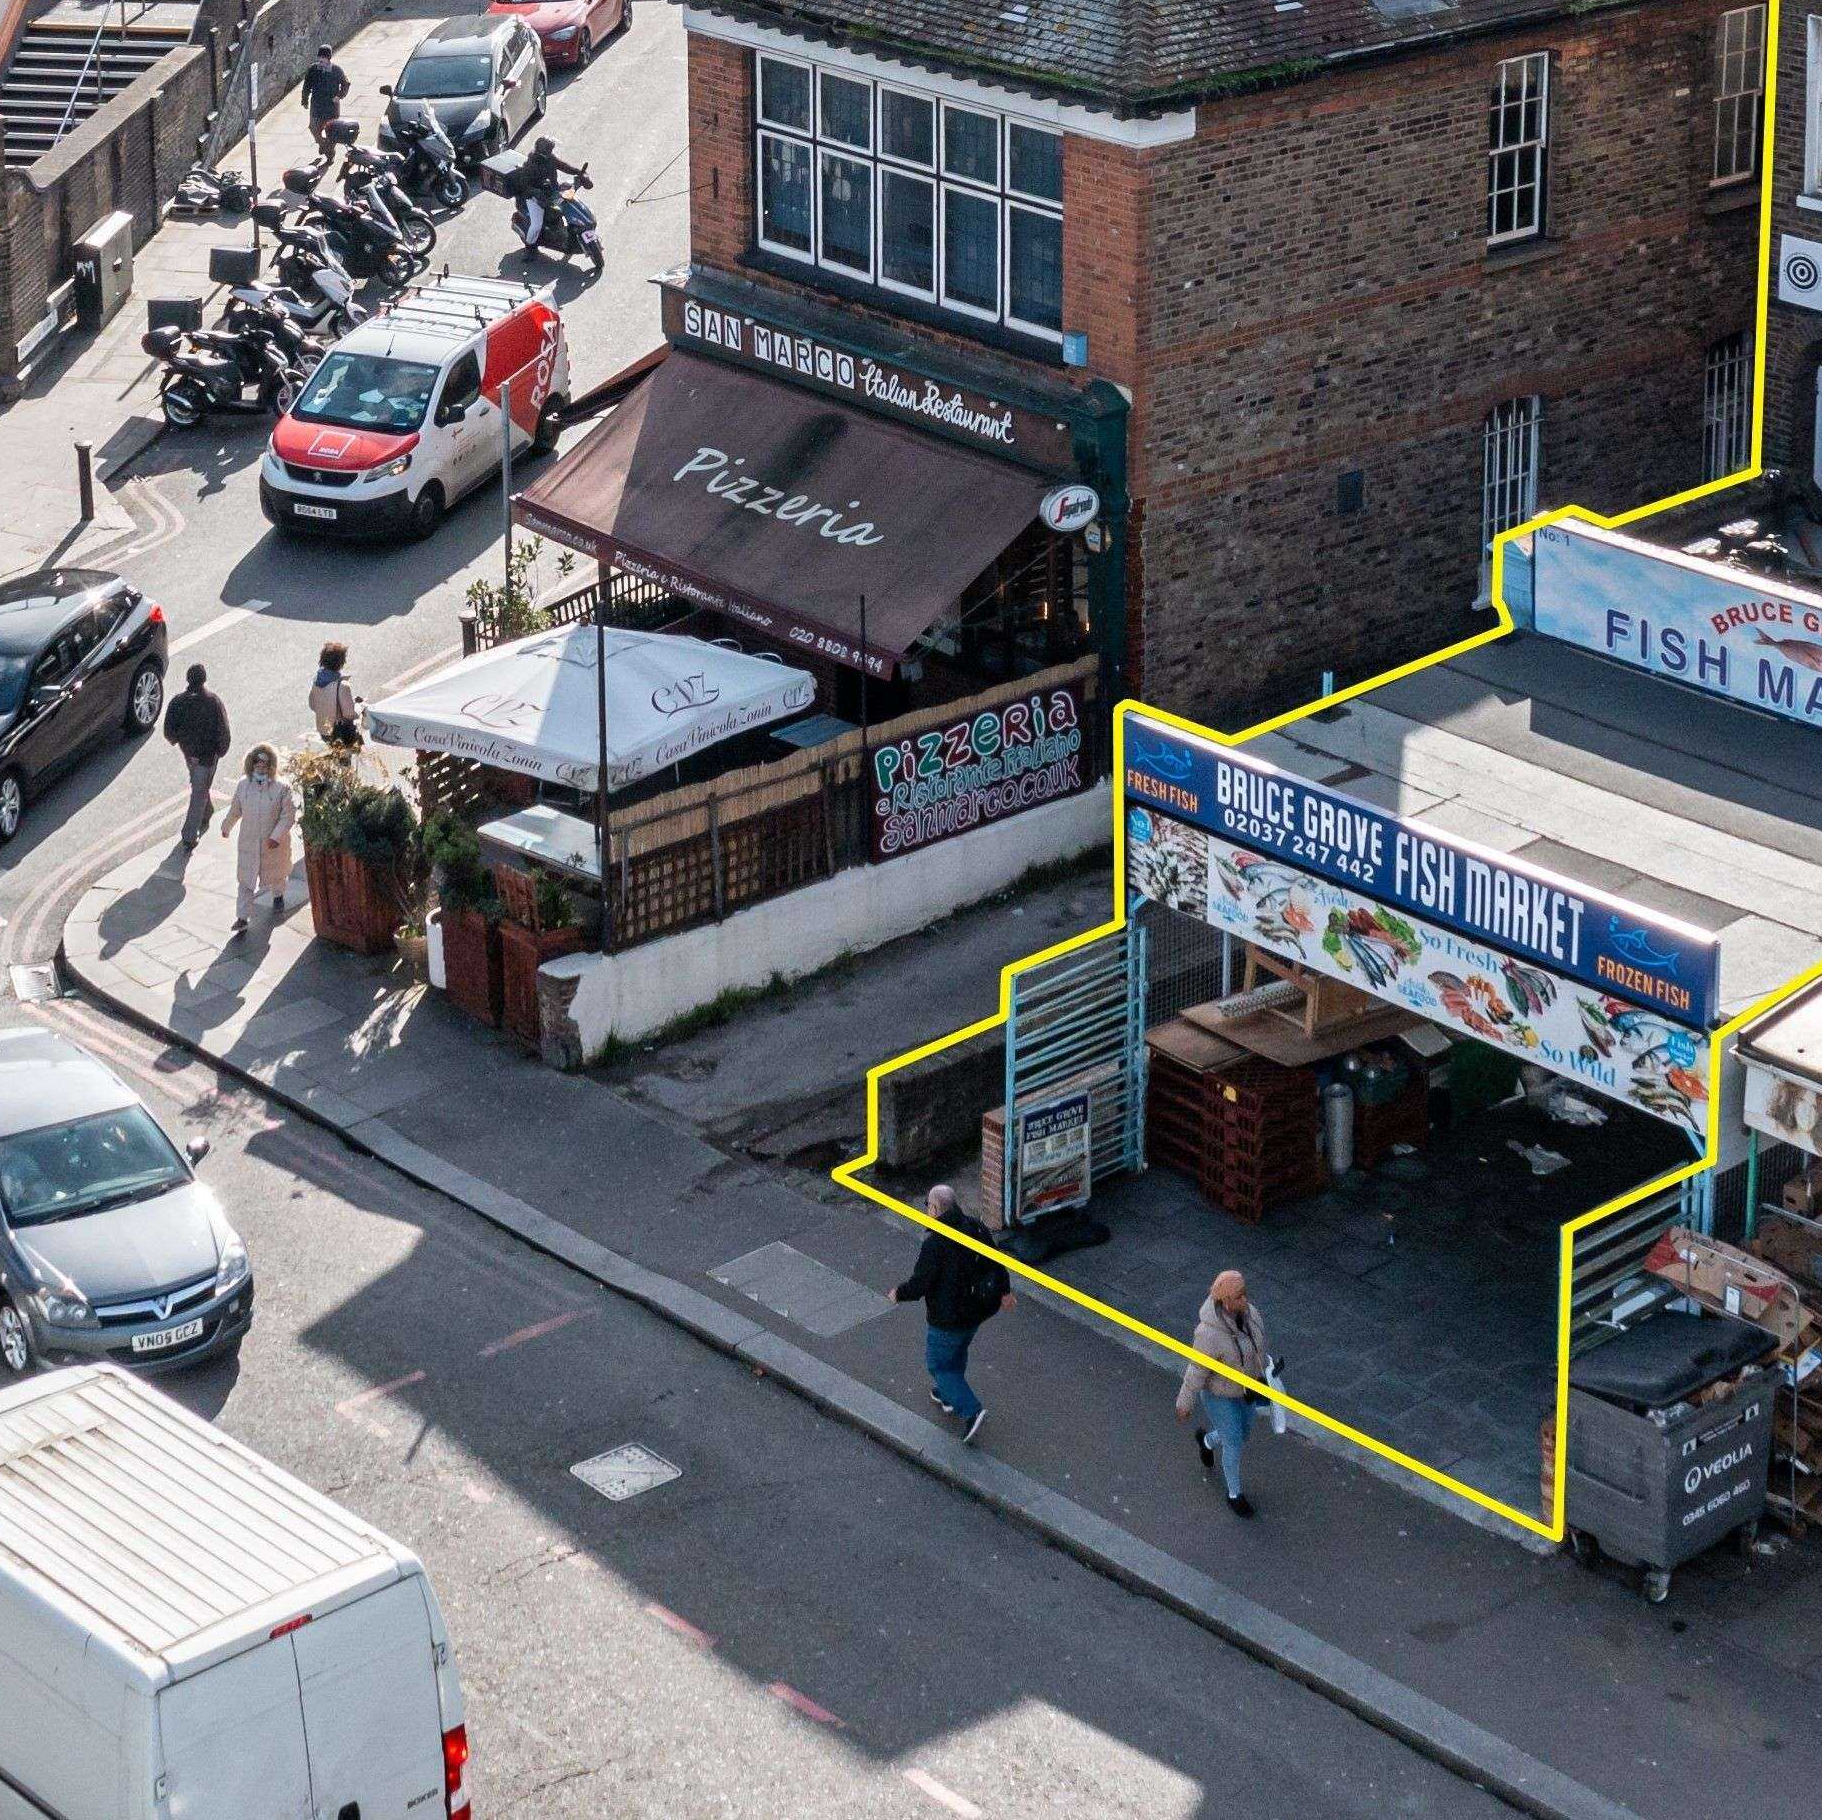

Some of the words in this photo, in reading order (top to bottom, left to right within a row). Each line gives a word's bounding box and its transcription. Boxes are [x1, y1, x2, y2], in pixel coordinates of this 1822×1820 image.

[686, 304, 741, 349] SAN
[755, 326, 854, 388] MARCO
[860, 362, 919, 410] Italian
[917, 381, 1014, 444] Restaurant
[673, 446, 883, 548] Pizzeria
[614, 550, 659, 580] Pizzeria
[1605, 607, 1729, 688] FISH
[1710, 601, 1793, 636] BRUCE
[892, 754, 1004, 815] Ristorante
[1126, 768, 1169, 803] FRESH
[1169, 786, 1199, 814] FISH
[1217, 761, 1296, 831] BRUCE
[1303, 794, 1384, 867] GROVE
[1394, 831, 1456, 917] FISH
[1464, 857, 1585, 967] MARKET
[1224, 808, 1287, 848] 02037
[1292, 836, 1331, 865] 247
[1335, 854, 1375, 885] 442
[1418, 928, 1442, 950] So
[1444, 938, 1500, 974] Fresh
[1597, 955, 1654, 997] FROZEN
[1656, 979, 1692, 1012] FISH
[1540, 1038, 1564, 1063] So
[1568, 1048, 1616, 1087] Wild
[1703, 1443, 1753, 1479] VEOLIA
